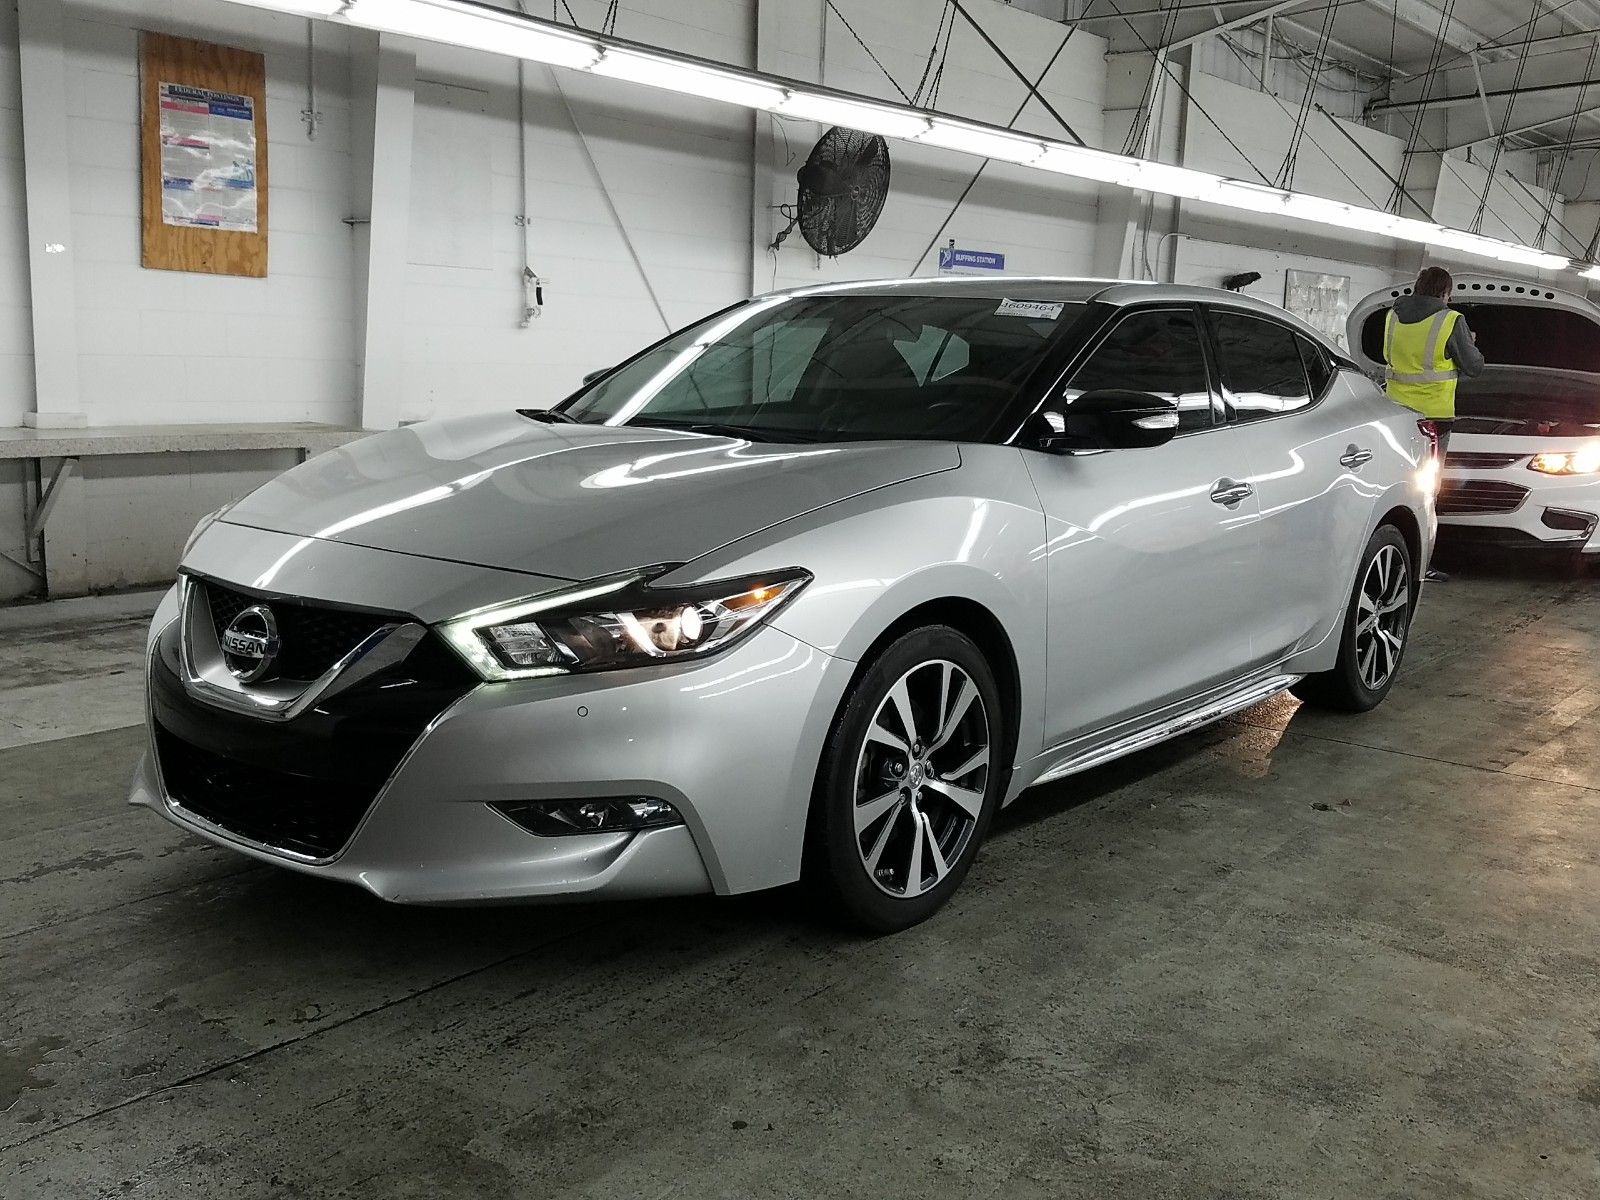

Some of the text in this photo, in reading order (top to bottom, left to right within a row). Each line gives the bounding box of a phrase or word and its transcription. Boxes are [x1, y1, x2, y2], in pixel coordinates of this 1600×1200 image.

[955, 253, 996, 265] BUFFING STATION
[225, 636, 267, 655] NISSAN
